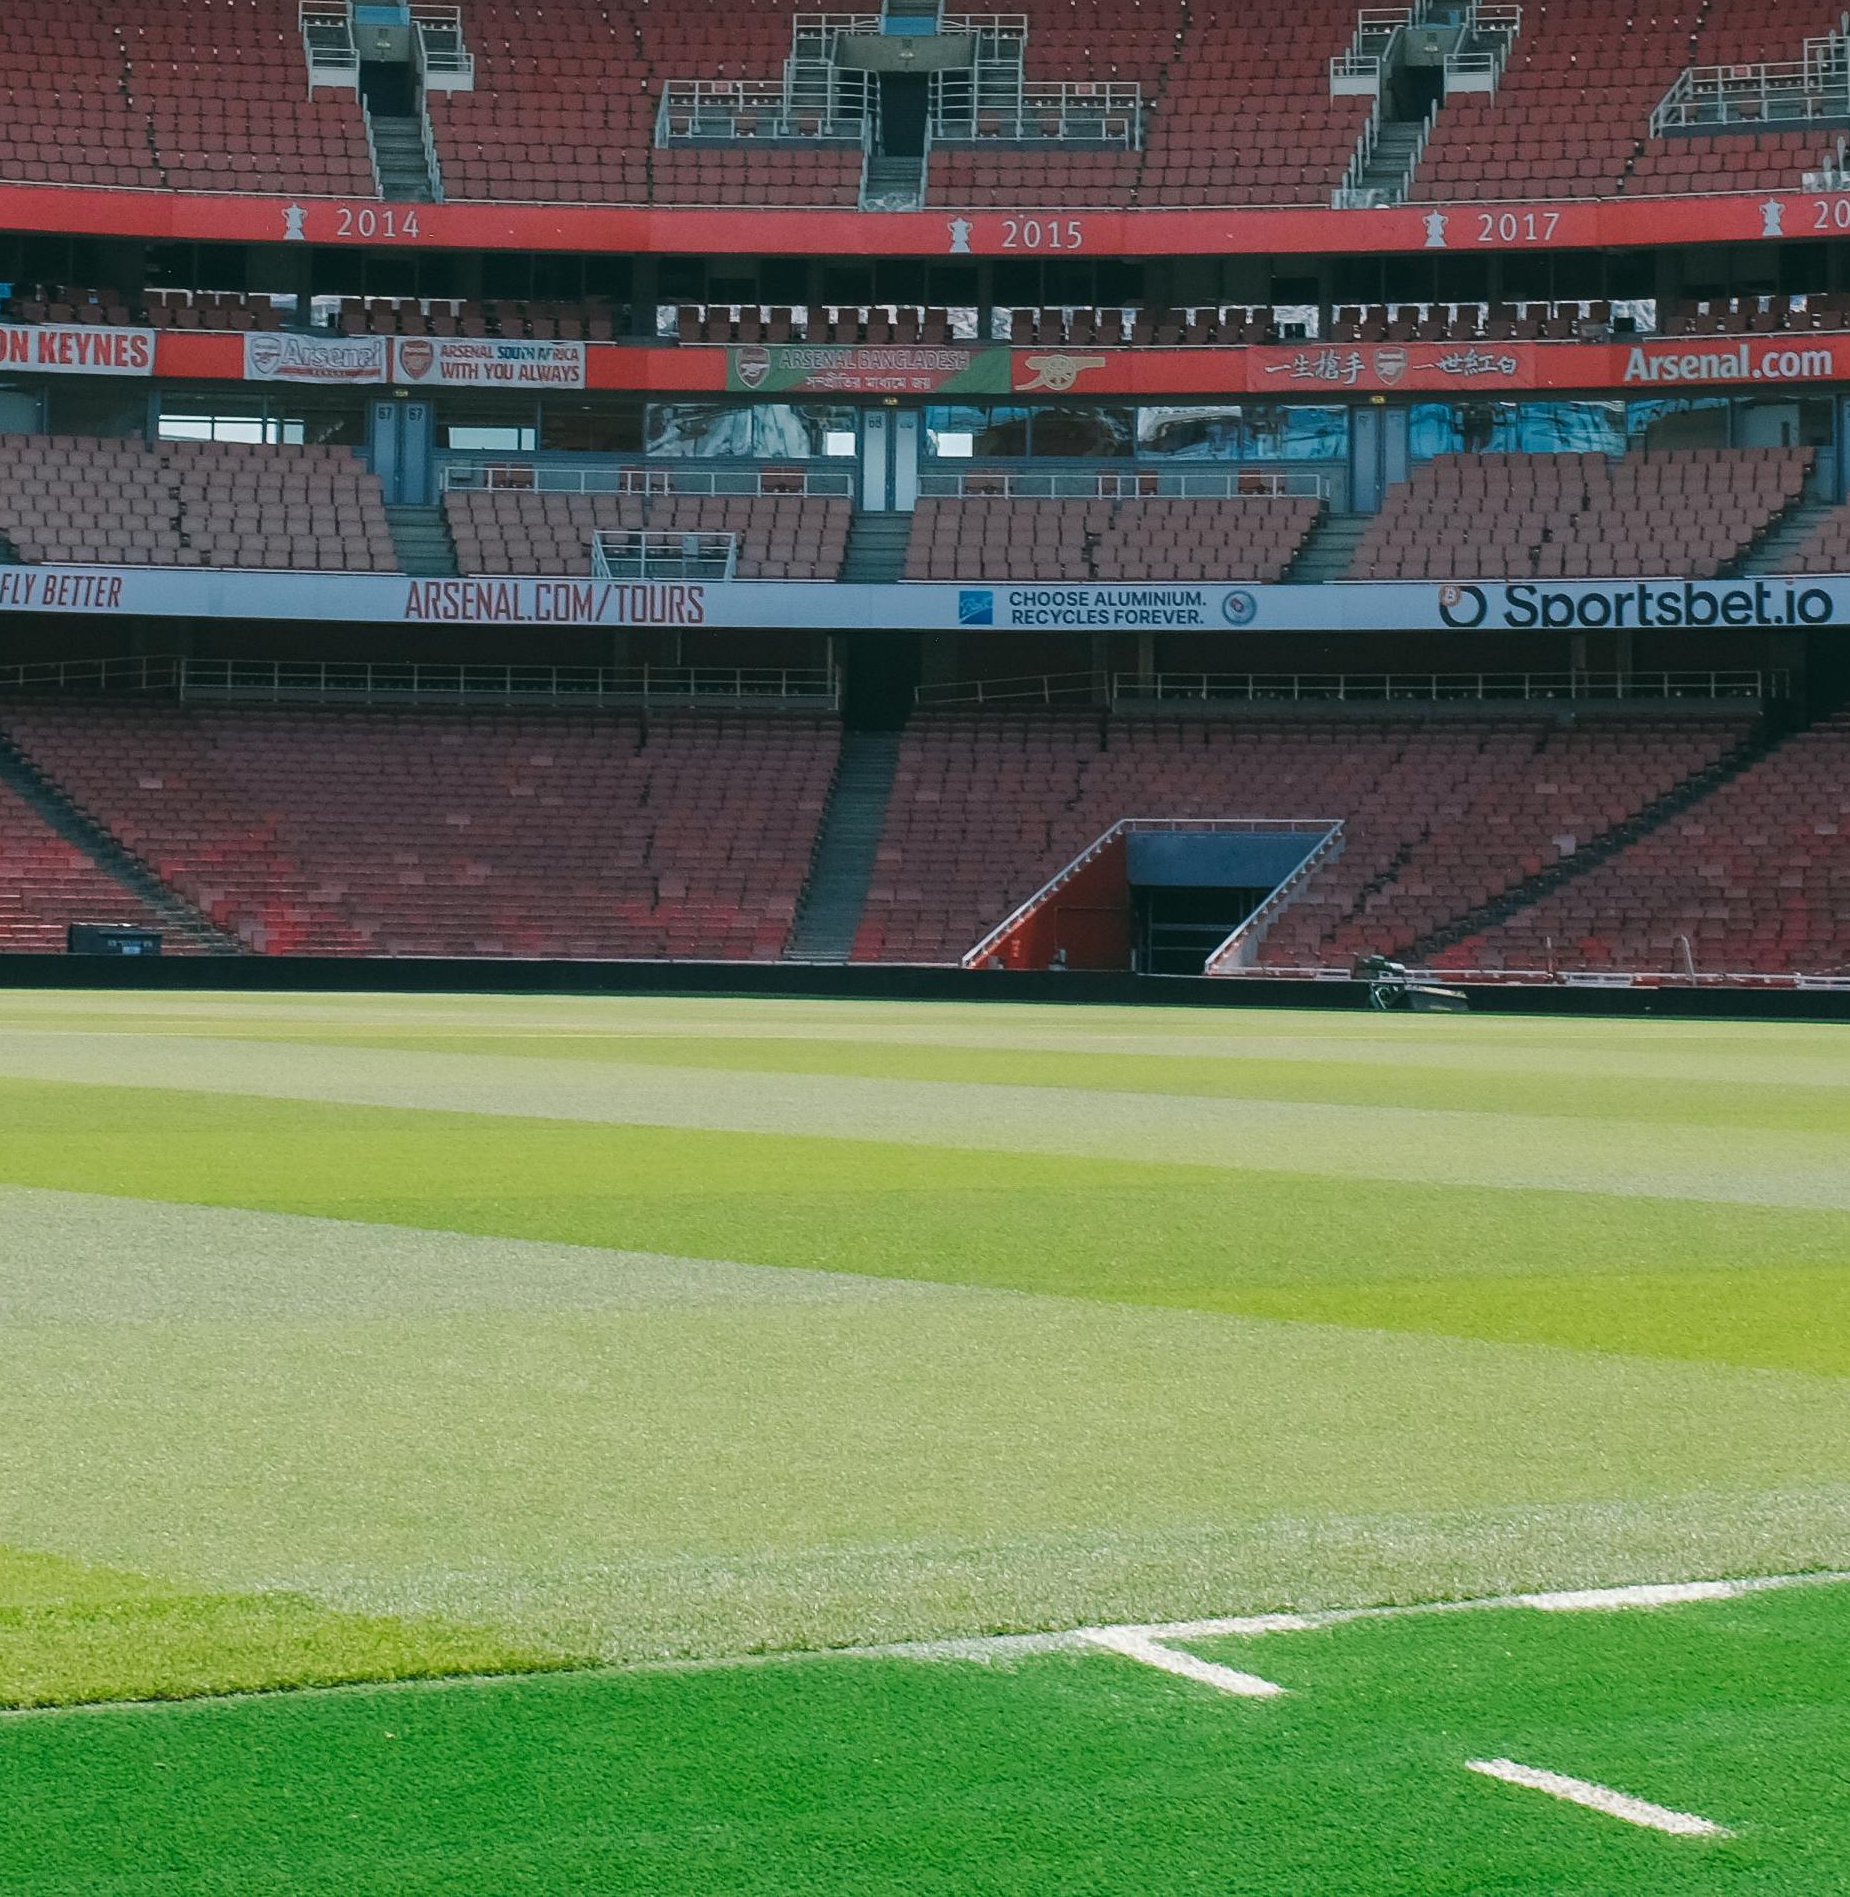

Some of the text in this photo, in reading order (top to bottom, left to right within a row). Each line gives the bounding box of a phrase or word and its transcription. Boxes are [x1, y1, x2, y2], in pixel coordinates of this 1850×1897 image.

[336, 208, 421, 239] 2014
[1002, 219, 1084, 250] 2015
[1477, 212, 1560, 243] 2017
[38, 331, 149, 368] KEYNES
[282, 339, 381, 368] Arsenal
[440, 344, 494, 360] ARSENAL
[779, 349, 971, 370] ARSENAL BANGLADESH
[1624, 343, 1833, 383] Arsenal.com
[441, 362, 580, 383] WITH YOU ALWAYS
[0, 572, 38, 605] FLY
[43, 575, 122, 608] BETTER
[404, 580, 705, 624] ARSENAL.COM/TOURS
[1009, 591, 1207, 607] CHOOSE ALUMINIUM.
[1012, 609, 1204, 625] RECYCLES FOREVER.
[1503, 583, 1834, 629] Sportsbet.io
